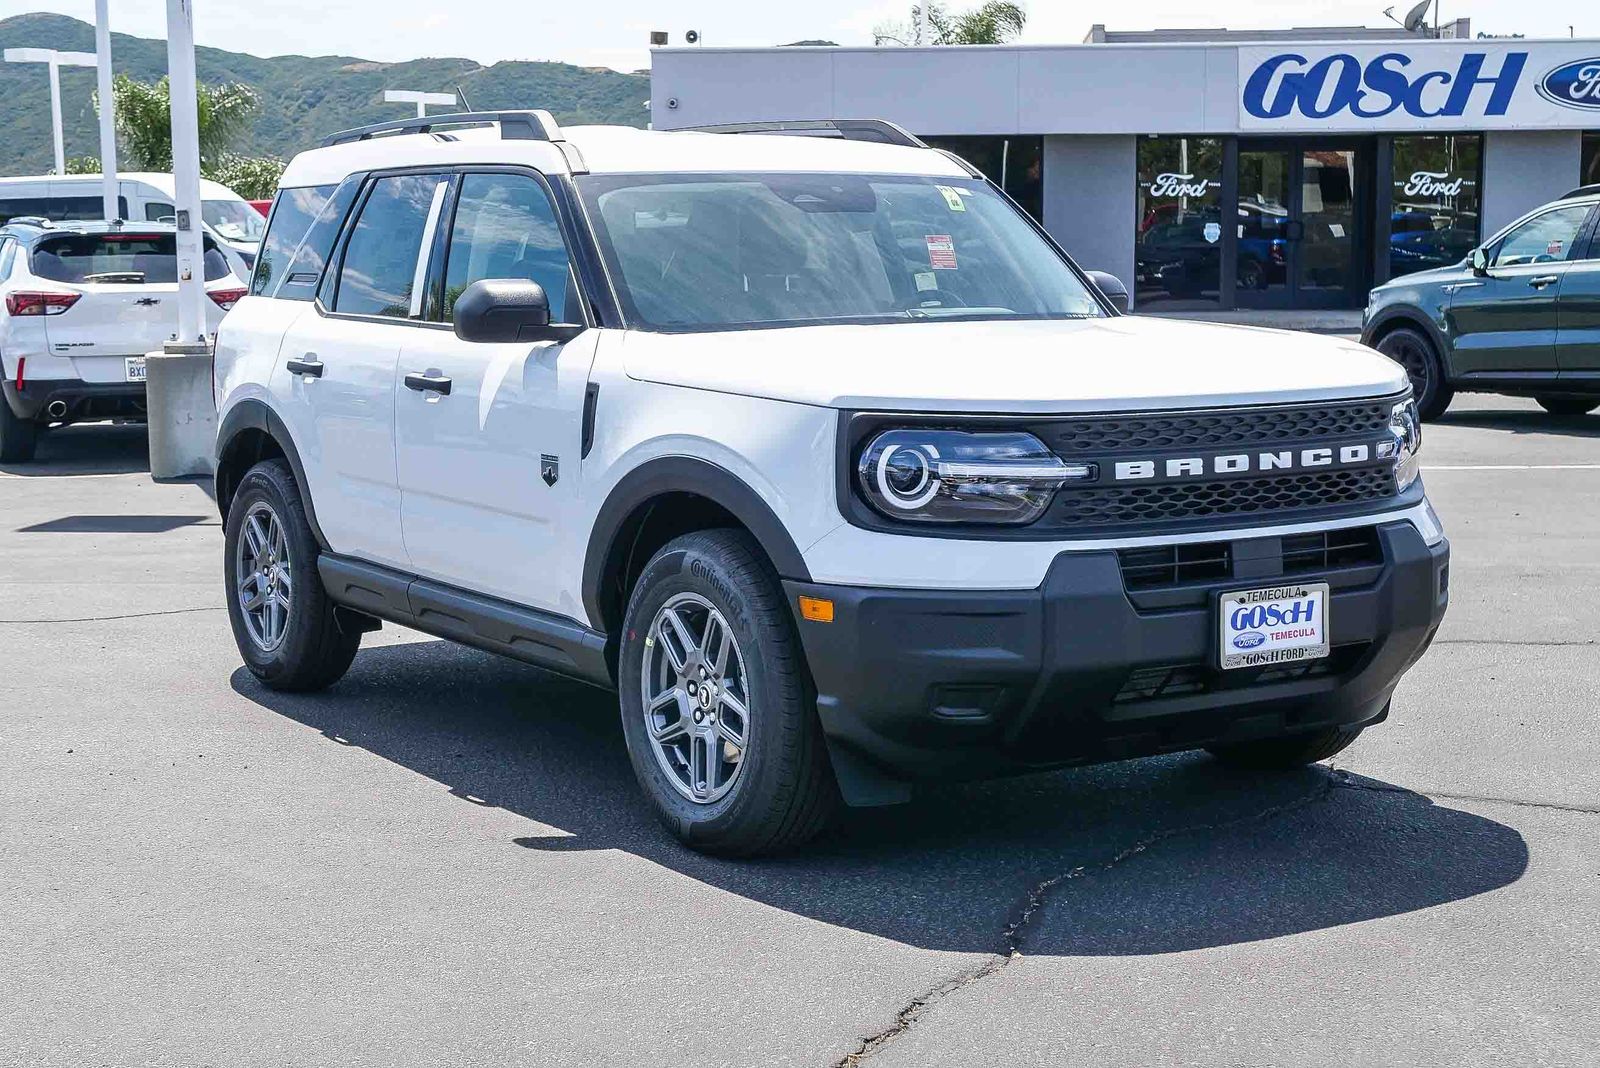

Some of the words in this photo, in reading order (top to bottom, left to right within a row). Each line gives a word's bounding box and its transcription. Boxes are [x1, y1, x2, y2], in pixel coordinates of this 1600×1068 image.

[1150, 172, 1208, 197] Ford
[1404, 171, 1463, 196] Ford
[1115, 444, 1369, 480] BRONCO
[1246, 587, 1302, 603] TEMECULA
[1238, 636, 1260, 647] Ford
[1270, 628, 1315, 641] TEMECULA
[1280, 648, 1304, 660] FORD
